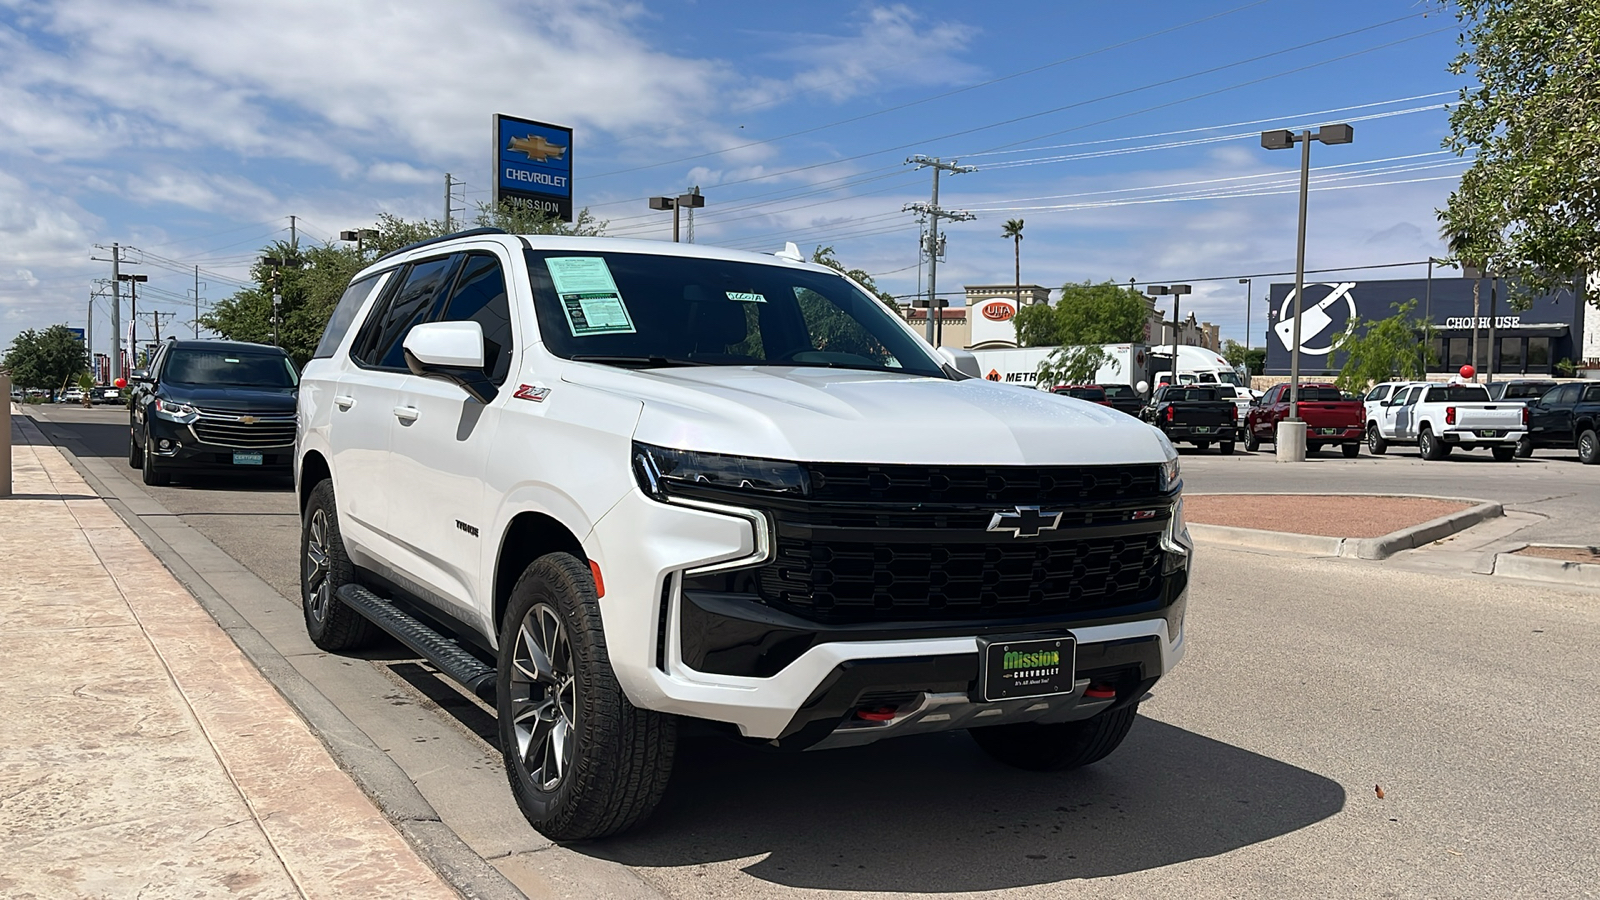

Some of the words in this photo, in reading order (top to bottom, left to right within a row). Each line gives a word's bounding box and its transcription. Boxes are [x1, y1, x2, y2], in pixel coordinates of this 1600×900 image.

[505, 168, 567, 187] CHEVROLET
[513, 384, 552, 403] Z71
[1013, 668, 1060, 679] CHEVROLET
